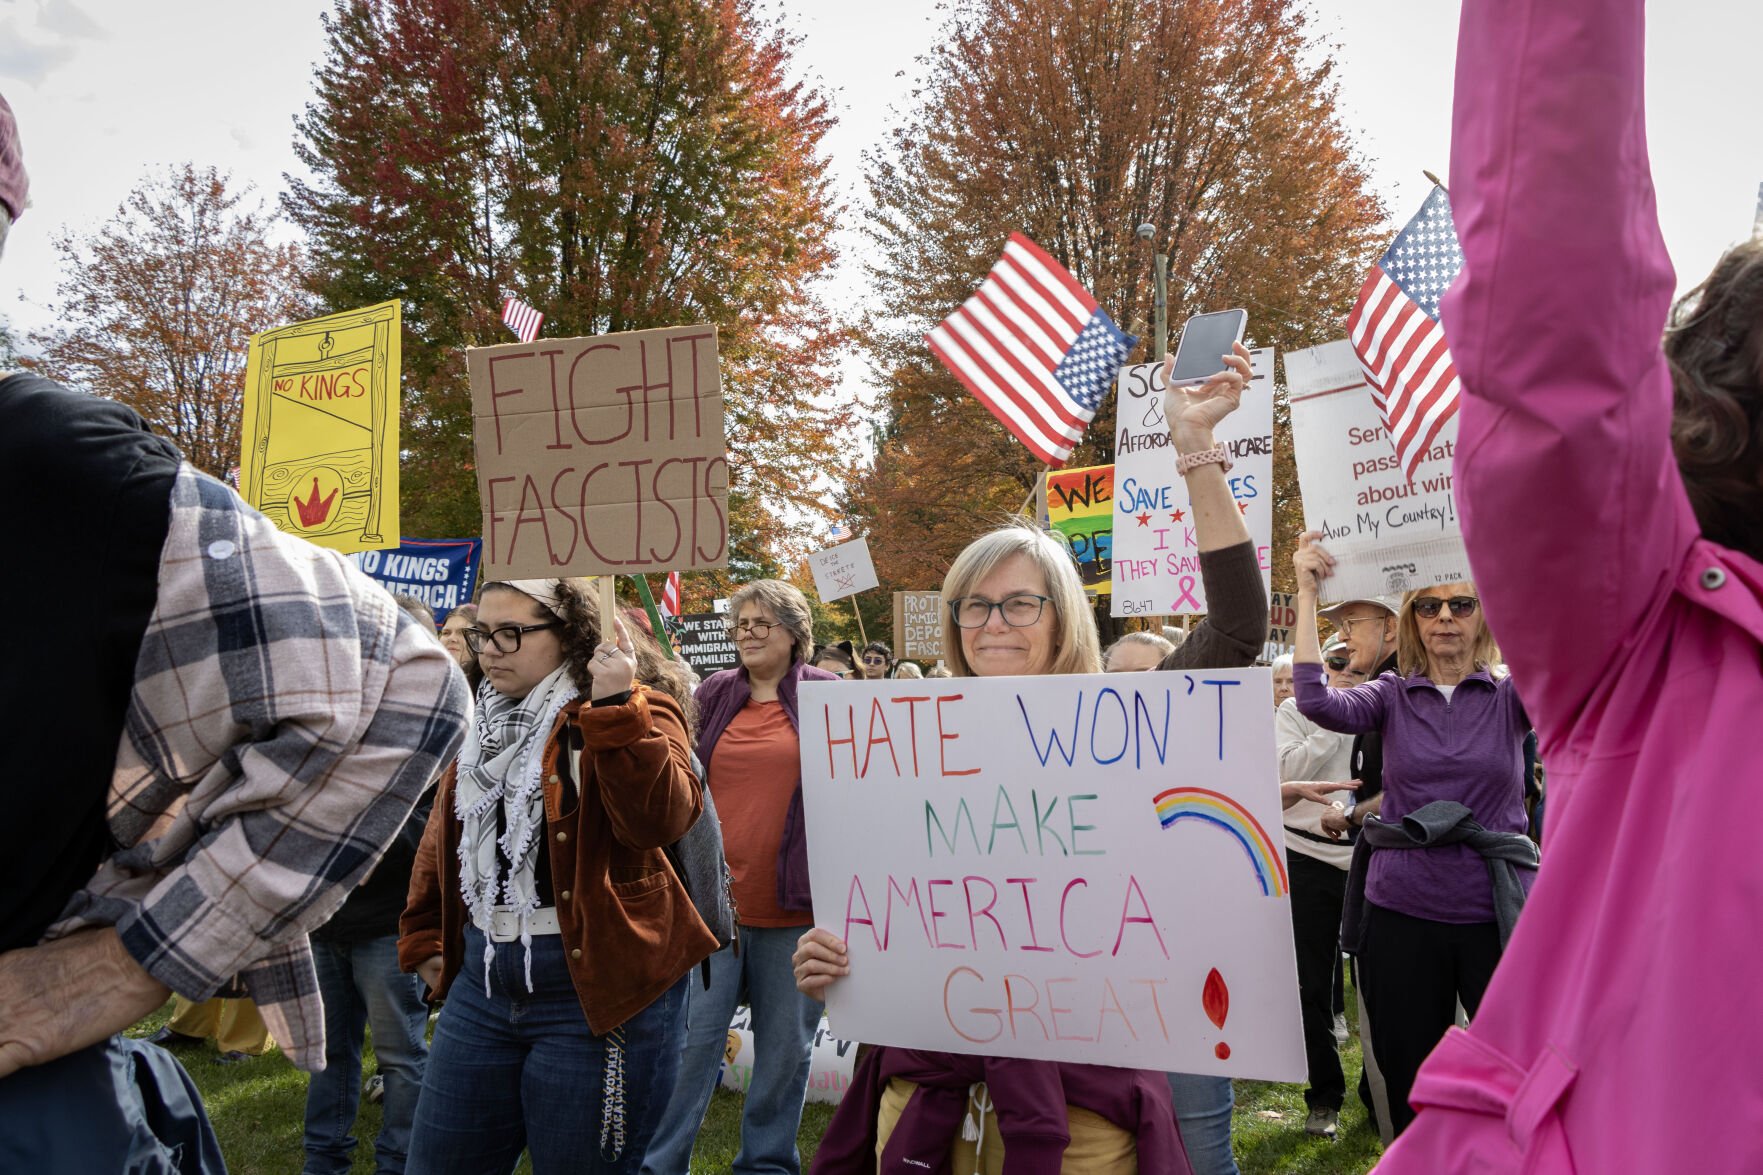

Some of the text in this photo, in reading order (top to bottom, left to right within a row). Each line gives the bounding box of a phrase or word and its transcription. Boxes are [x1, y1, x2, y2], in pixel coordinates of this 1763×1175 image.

[274, 367, 369, 401] NO KINGS
[489, 333, 713, 455] FIGHT
[1142, 396, 1164, 428] &
[1053, 474, 1112, 513] WE
[1119, 478, 1173, 514] SAVE
[1356, 478, 1419, 507] about
[488, 456, 728, 567] FASCISTS
[1152, 528, 1171, 551] I
[383, 553, 450, 582] KINGS
[1114, 558, 1158, 583] THEY
[1445, 572, 1462, 581] PACK
[1122, 600, 1153, 615] 8647
[1271, 593, 1292, 607] AY
[684, 622, 701, 631] WE
[1271, 606, 1297, 627] UD
[697, 631, 726, 642] WITH
[905, 625, 943, 642] DEPO
[1269, 628, 1289, 642] AY
[682, 642, 737, 655] IMMIGRAN
[690, 653, 736, 666] FAMILIES
[824, 675, 1242, 779] HATE WON'T
[924, 784, 1107, 858] MAKE
[843, 874, 1171, 961] AMERICA
[600, 1047, 619, 1149] ITHACA COLLEG
